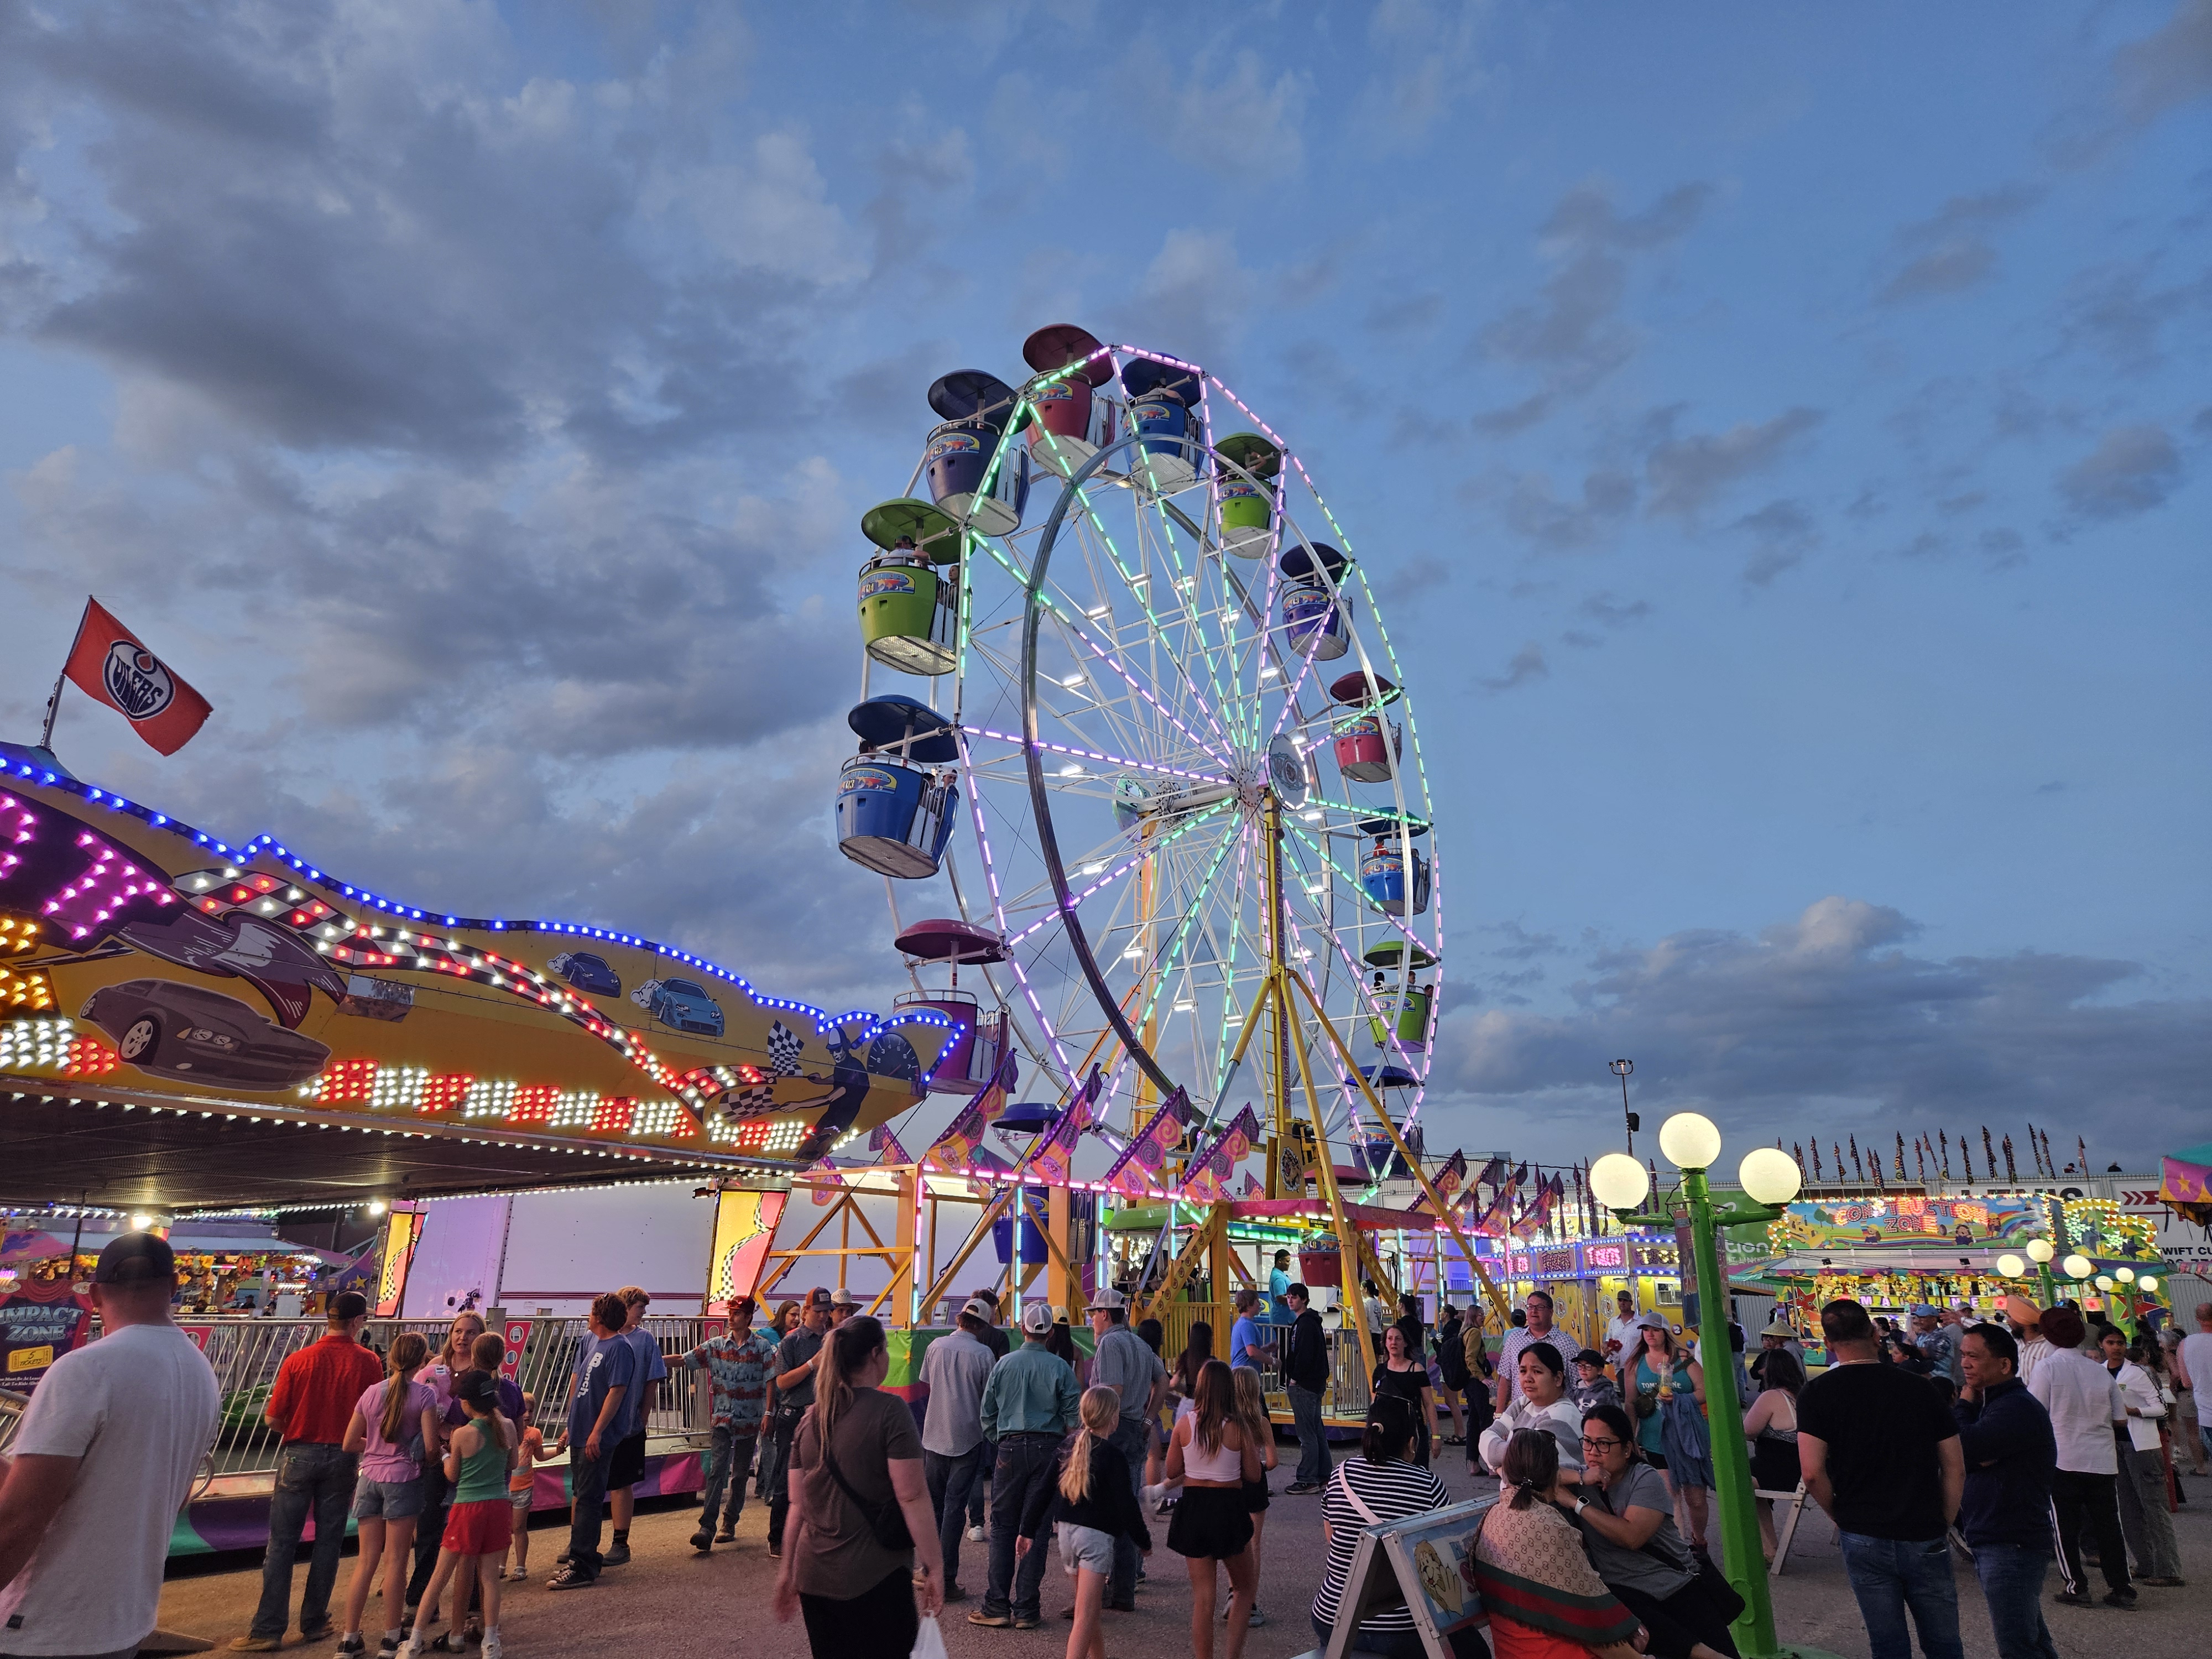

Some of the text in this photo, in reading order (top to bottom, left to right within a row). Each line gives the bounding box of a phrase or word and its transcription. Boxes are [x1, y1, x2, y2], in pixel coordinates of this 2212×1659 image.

[112, 655, 165, 713] OILERS
[1834, 1196, 1988, 1228] CONSTRUCTION
[1884, 1215, 1938, 1234] ZONE
[2159, 1247, 2193, 1255] WIFT
[0, 1306, 85, 1324] IMPACT
[6, 1324, 66, 1342] ZONE
[20, 1358, 43, 1366] TICKETS
[29, 1351, 35, 1359] 5
[577, 1352, 603, 1398] Bench.
